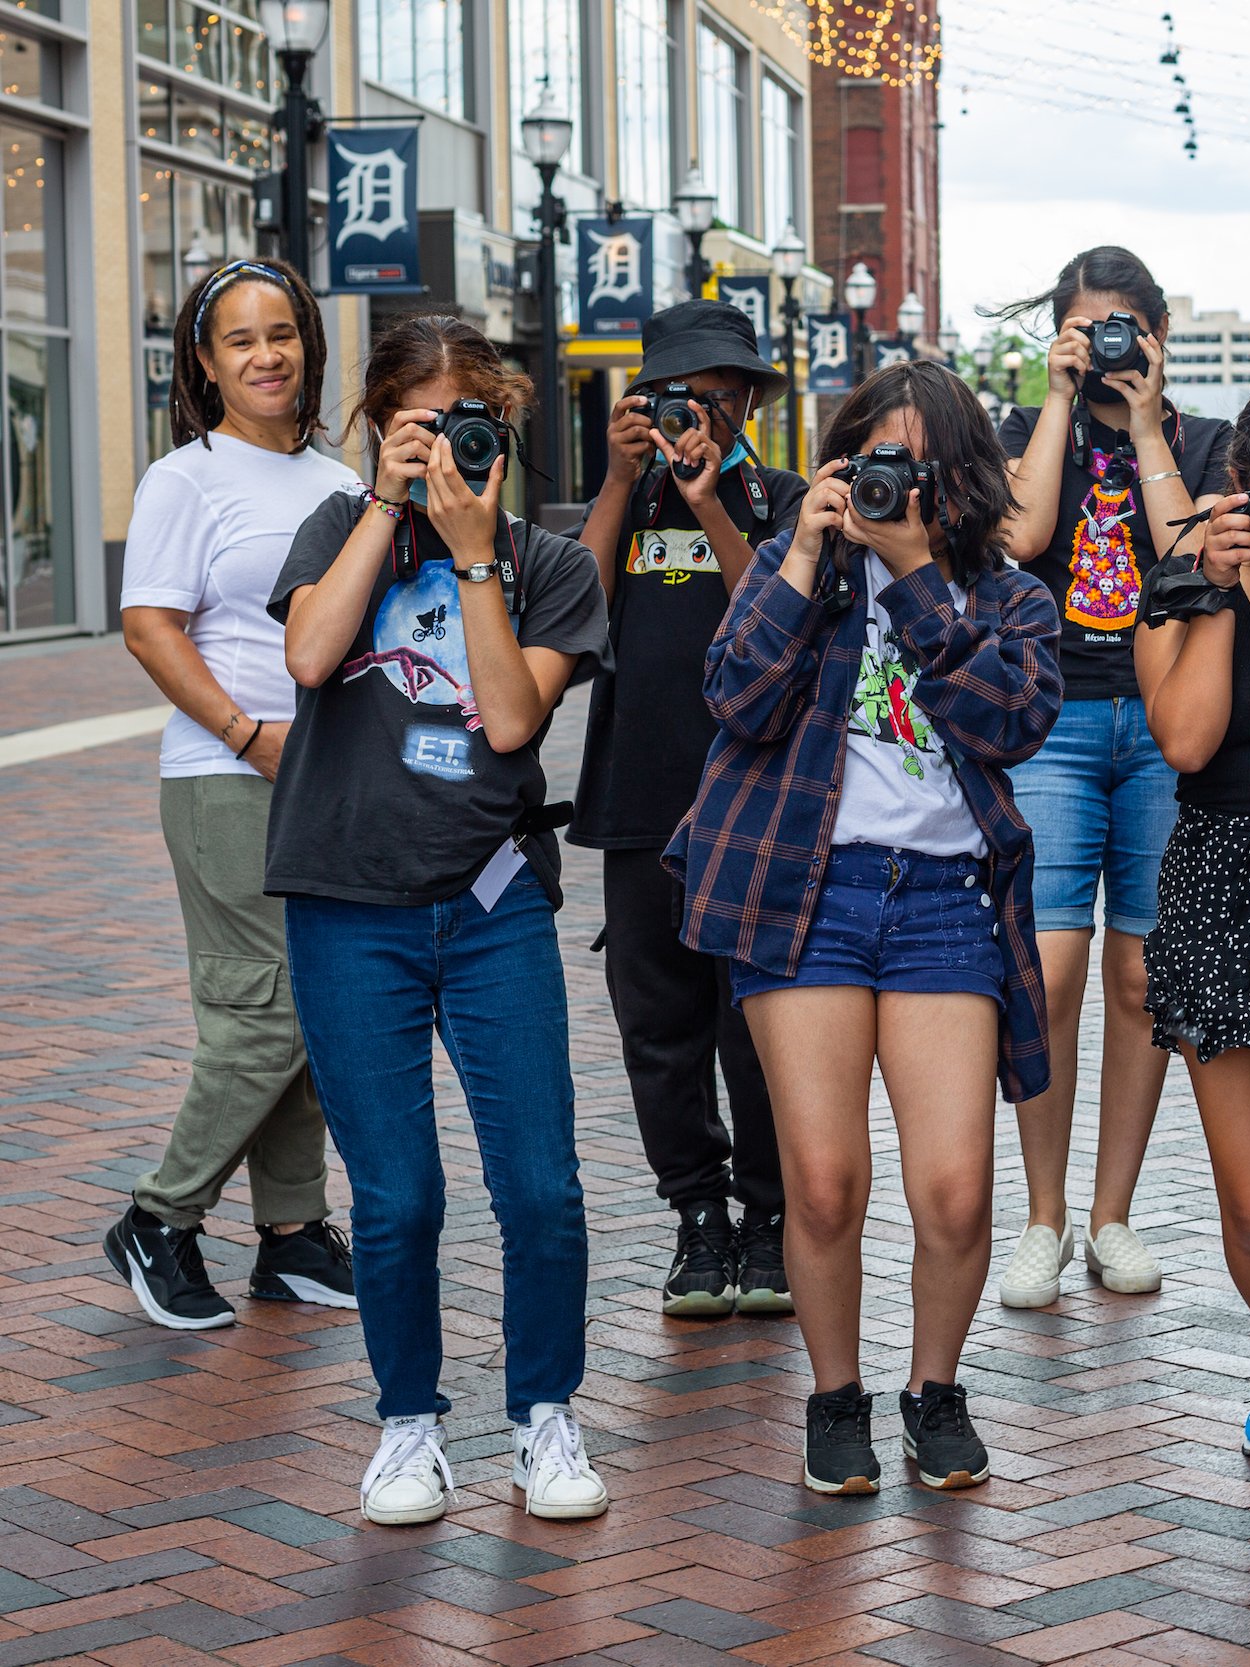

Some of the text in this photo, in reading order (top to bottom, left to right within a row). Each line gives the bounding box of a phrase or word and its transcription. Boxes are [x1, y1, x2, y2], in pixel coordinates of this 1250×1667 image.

[335, 142, 409, 251] D
[587, 229, 643, 309] D
[1112, 311, 1131, 319] Canon
[668, 384, 688, 392] Canon
[462, 401, 485, 410] Canon
[1074, 421, 1085, 447] Canon
[875, 448, 897, 456] Canon
[748, 482, 763, 499] EOS
[500, 560, 515, 583] EOS
[662, 569, 692, 585] ゴン
[416, 735, 469, 766] E.T.
